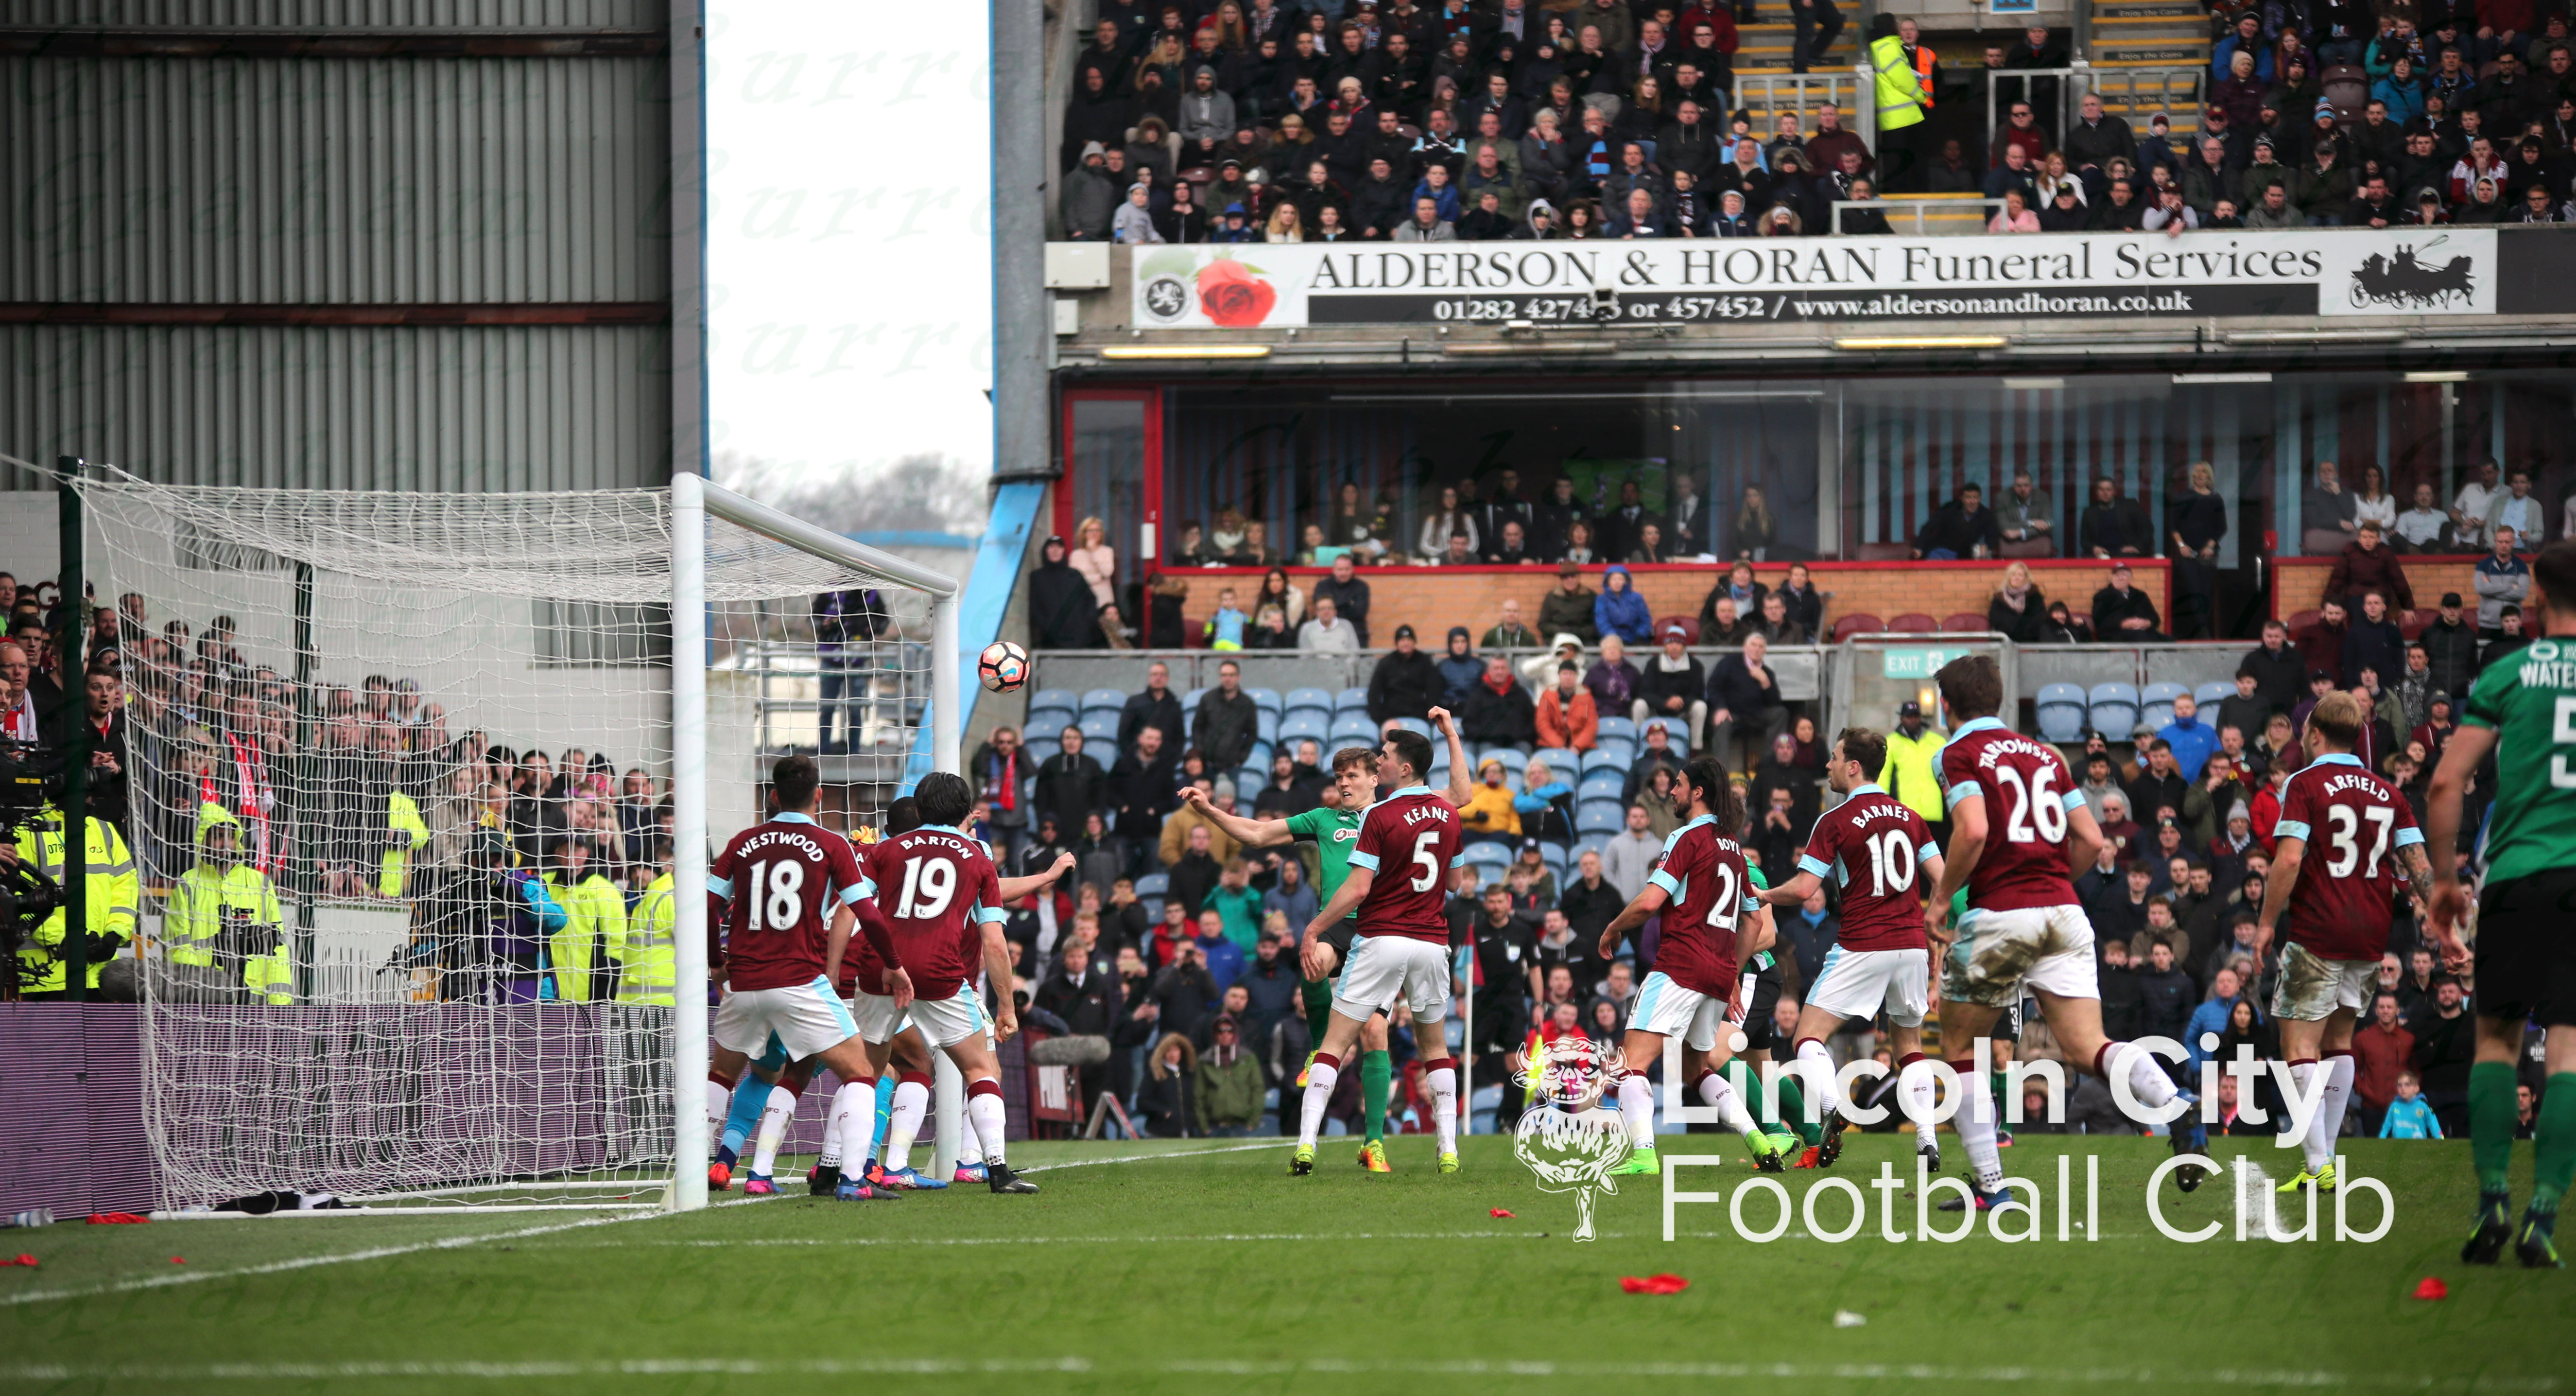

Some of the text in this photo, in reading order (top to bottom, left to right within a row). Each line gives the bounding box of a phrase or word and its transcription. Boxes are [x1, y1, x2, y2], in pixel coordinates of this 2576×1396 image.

[1309, 241, 2323, 289] ALDERSON & HORAN Funeral Services
[1434, 300, 1516, 320] 01282
[1629, 302, 1660, 318] or
[1667, 295, 1765, 319] 457452
[1793, 290, 2193, 317] www.aldersonandhoran.co.uk
[1888, 655, 1921, 672] EXIT
[2518, 660, 2576, 689] WATE
[2323, 774, 2390, 803] ARFIELD
[1402, 805, 1450, 826] KEANE
[1851, 804, 1910, 828] BARNES
[1995, 765, 2068, 844] 26
[736, 831, 824, 863] WESTWOOD
[900, 835, 973, 861] BARTON
[2326, 803, 2395, 879] 37
[1410, 830, 1440, 893] 5
[1865, 829, 1916, 897] 10
[748, 858, 804, 931] 18
[894, 855, 957, 920] 19
[1706, 862, 1742, 933] 21
[1314, 1082, 1329, 1091] BFC
[1715, 1089, 1731, 1101] BFC
[892, 1105, 907, 1114] BFC
